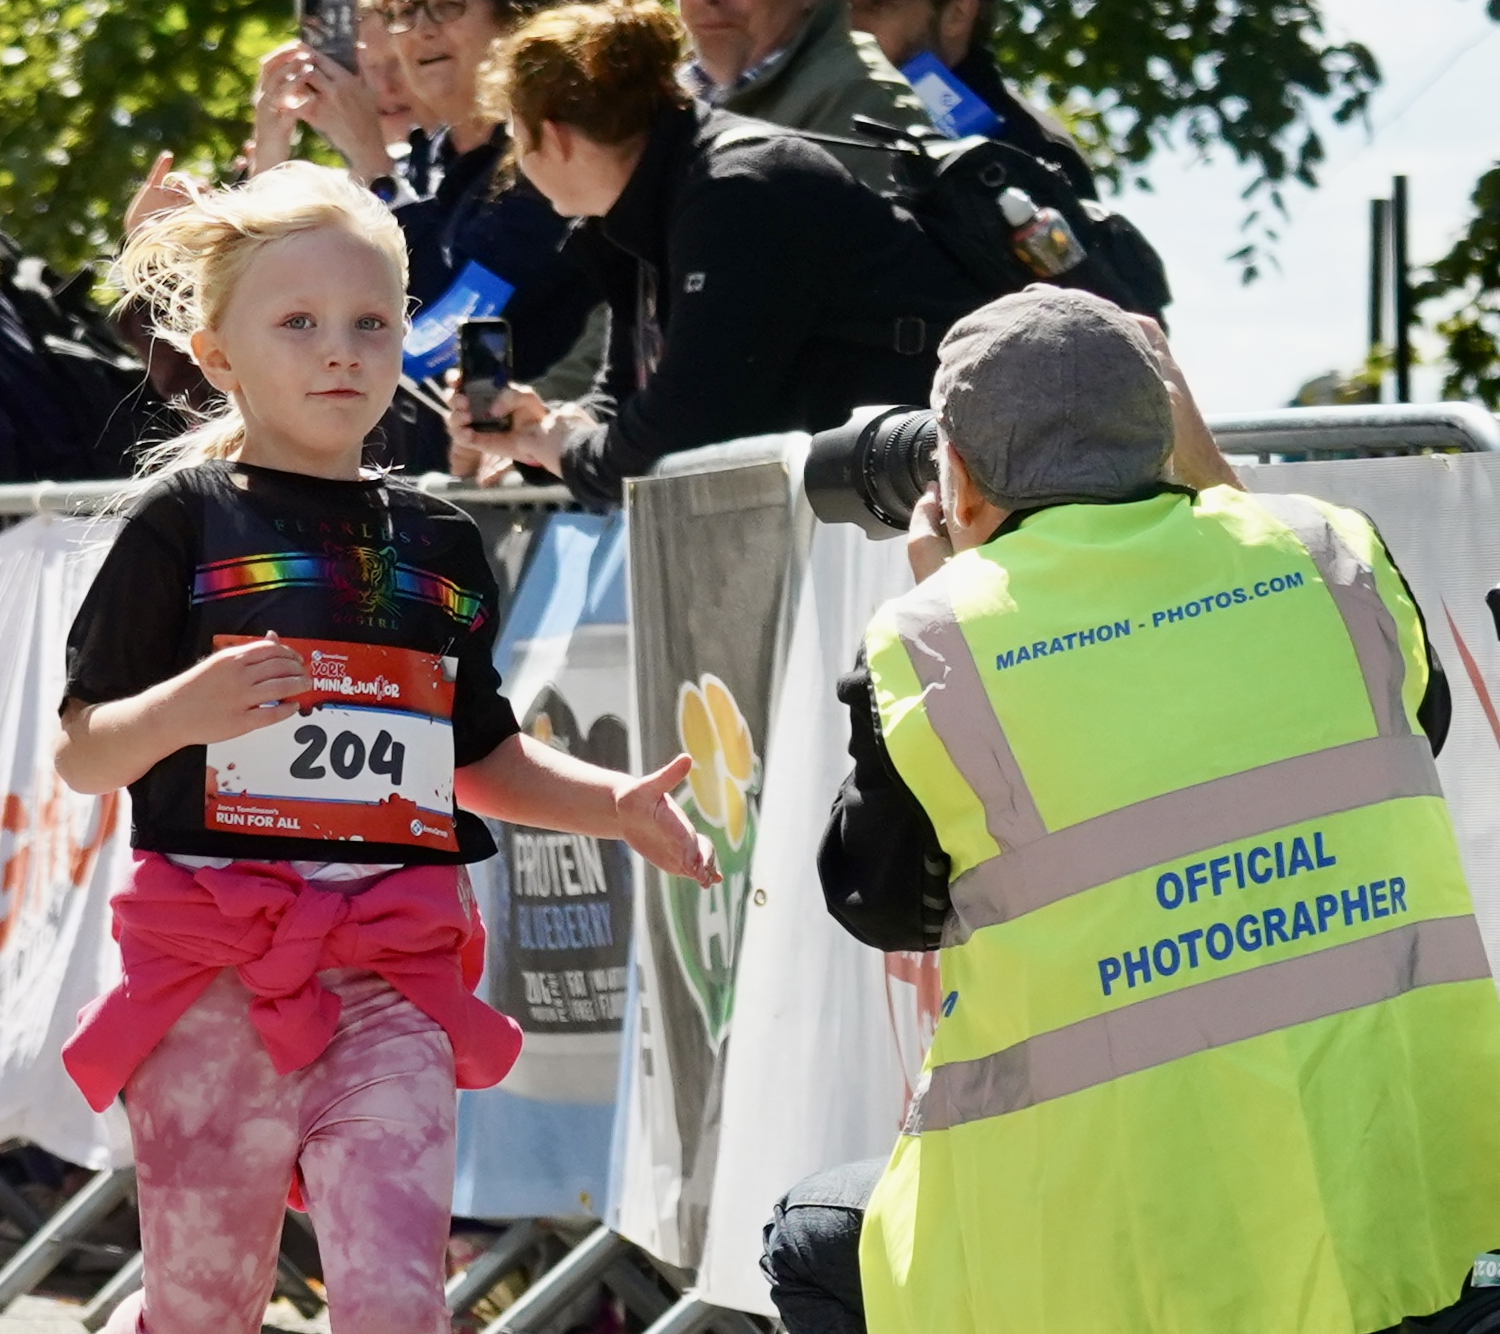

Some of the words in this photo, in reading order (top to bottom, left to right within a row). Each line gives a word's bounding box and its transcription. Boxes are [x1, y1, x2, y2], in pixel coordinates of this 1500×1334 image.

[995, 618, 1132, 672] MARATHON
[1151, 571, 1305, 630] PHOTOS.COM
[311, 661, 347, 678] YORK
[289, 723, 407, 787] 204
[215, 812, 246, 827] RUN
[247, 814, 275, 829] FOR
[276, 817, 301, 830] ALL
[511, 832, 609, 898] PROTEIN
[1154, 830, 1338, 911] OFFICIAL
[1096, 876, 1409, 998] PHOTOGRAPHER
